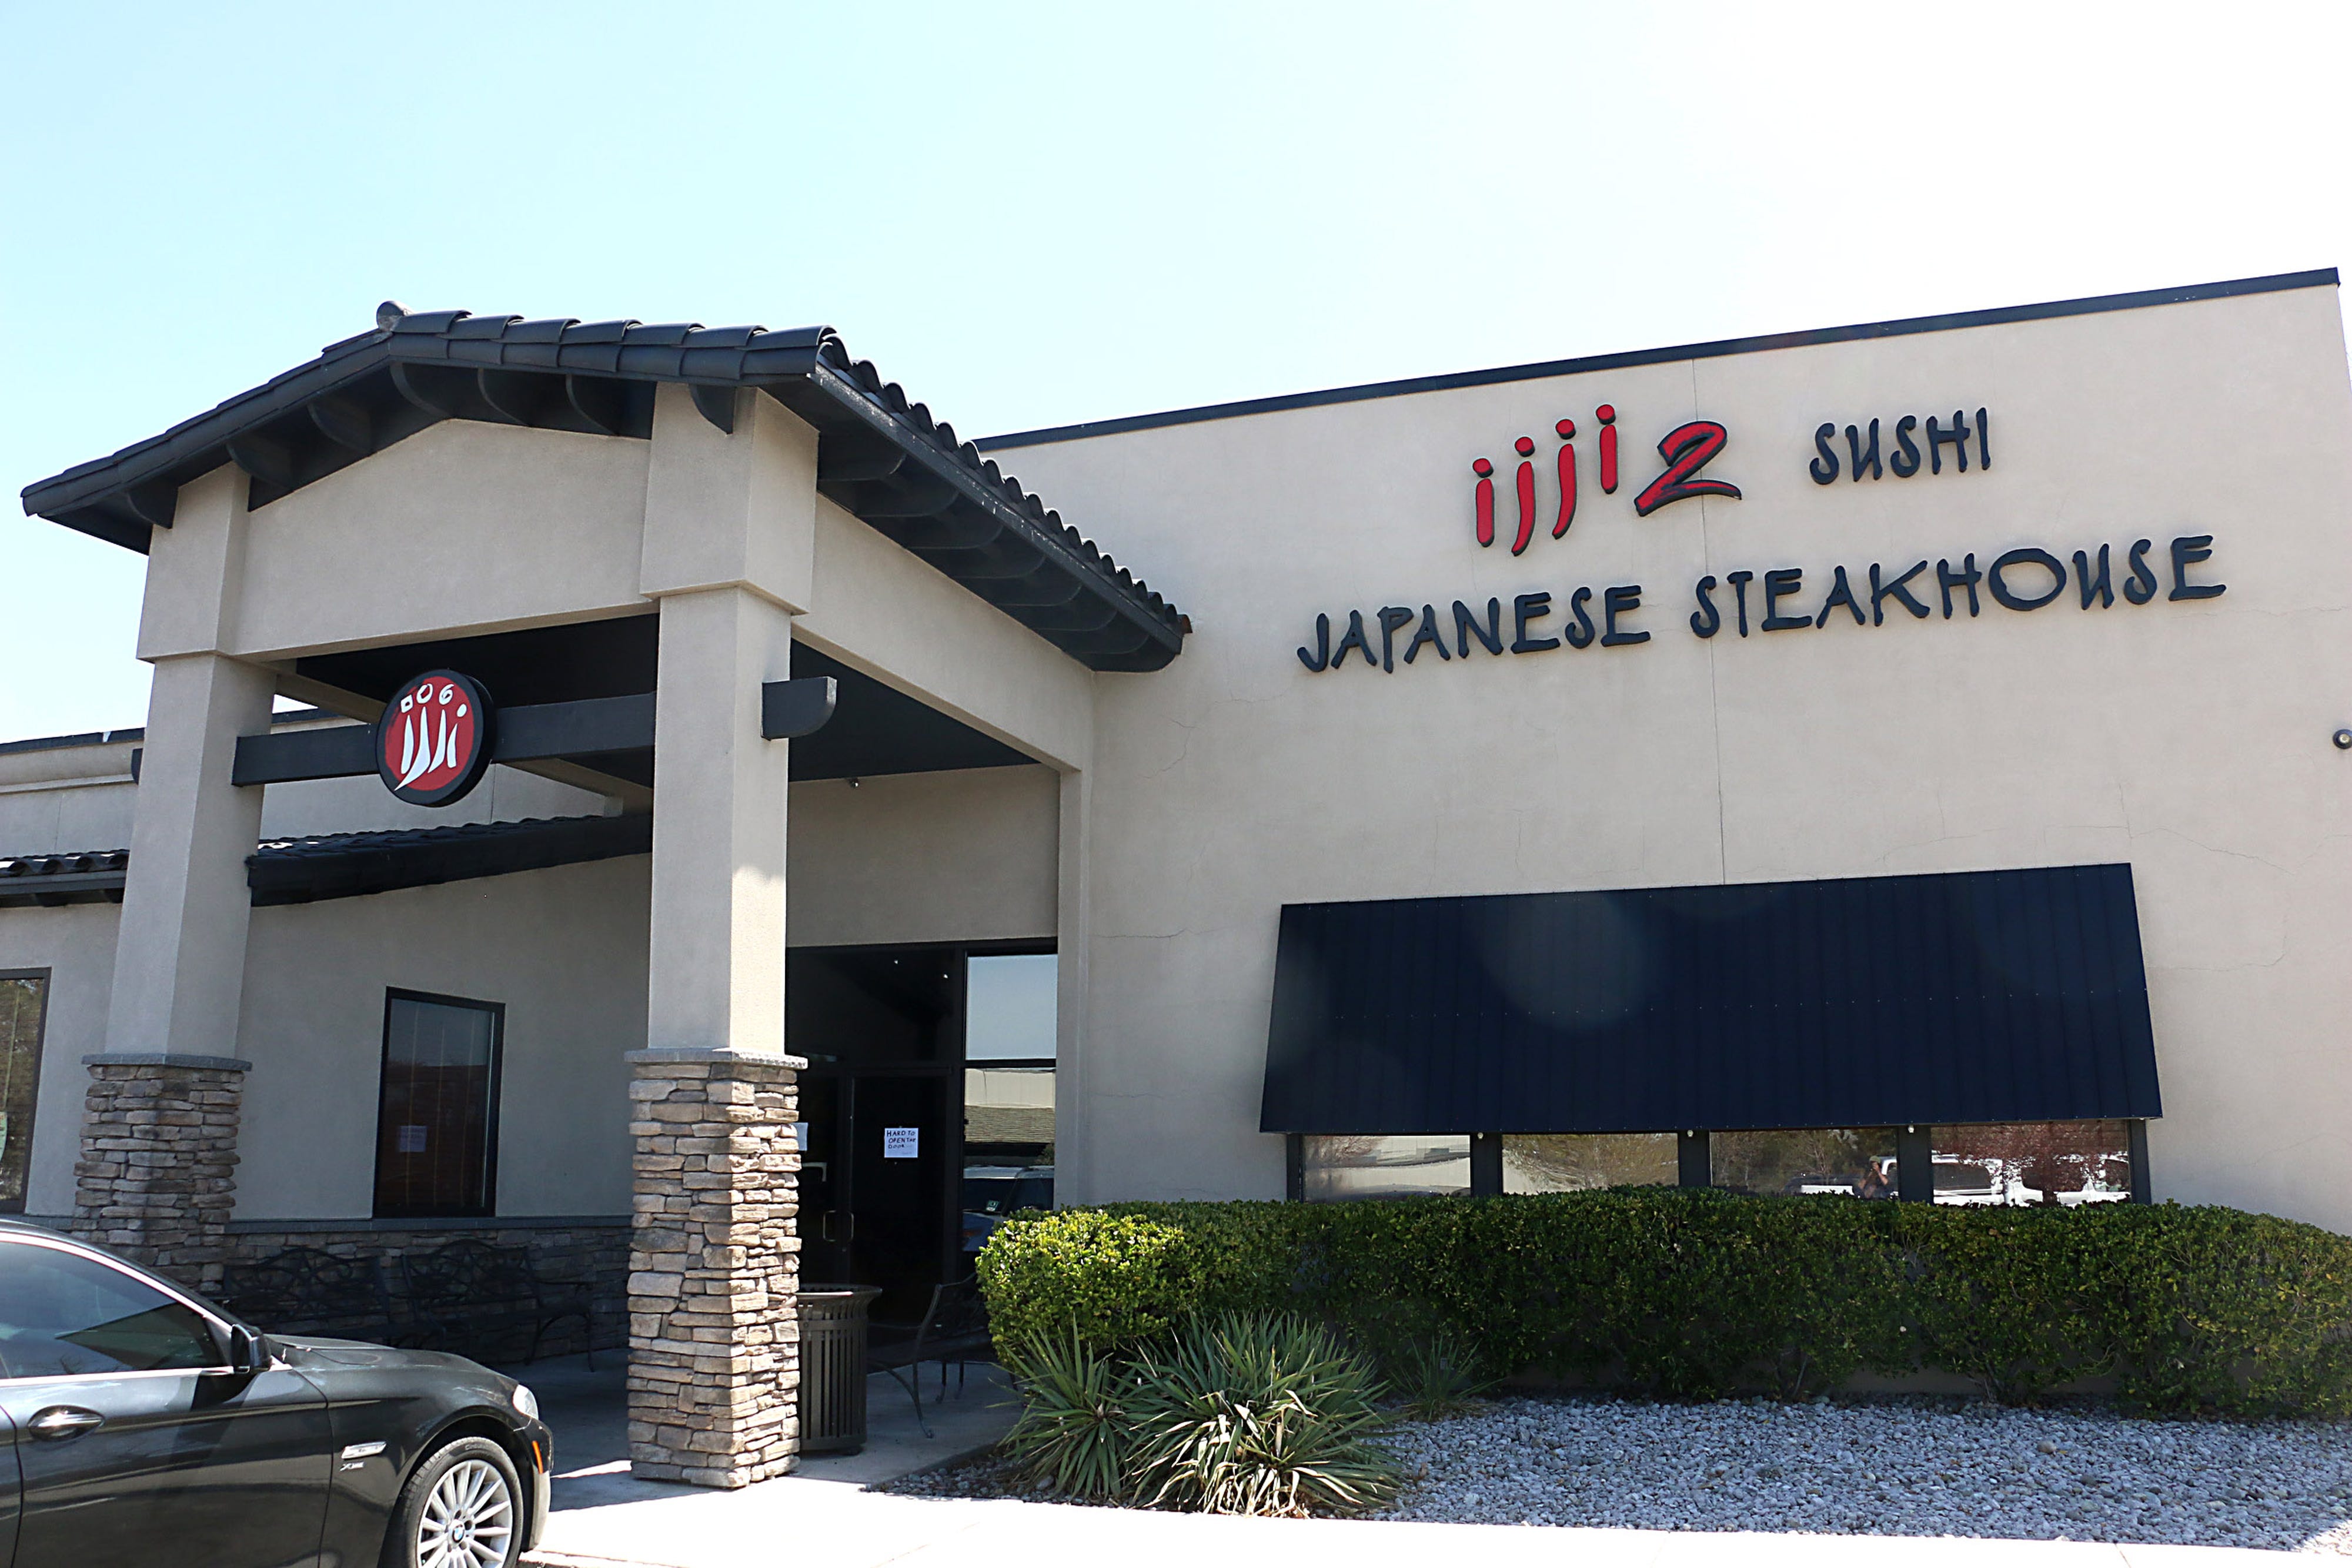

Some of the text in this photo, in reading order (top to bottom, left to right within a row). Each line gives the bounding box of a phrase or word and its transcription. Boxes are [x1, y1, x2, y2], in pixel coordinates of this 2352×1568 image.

[1472, 404, 1992, 557] ijji 2 SUSHI
[1297, 534, 2227, 674] JAPANESE STEAKHOUSE
